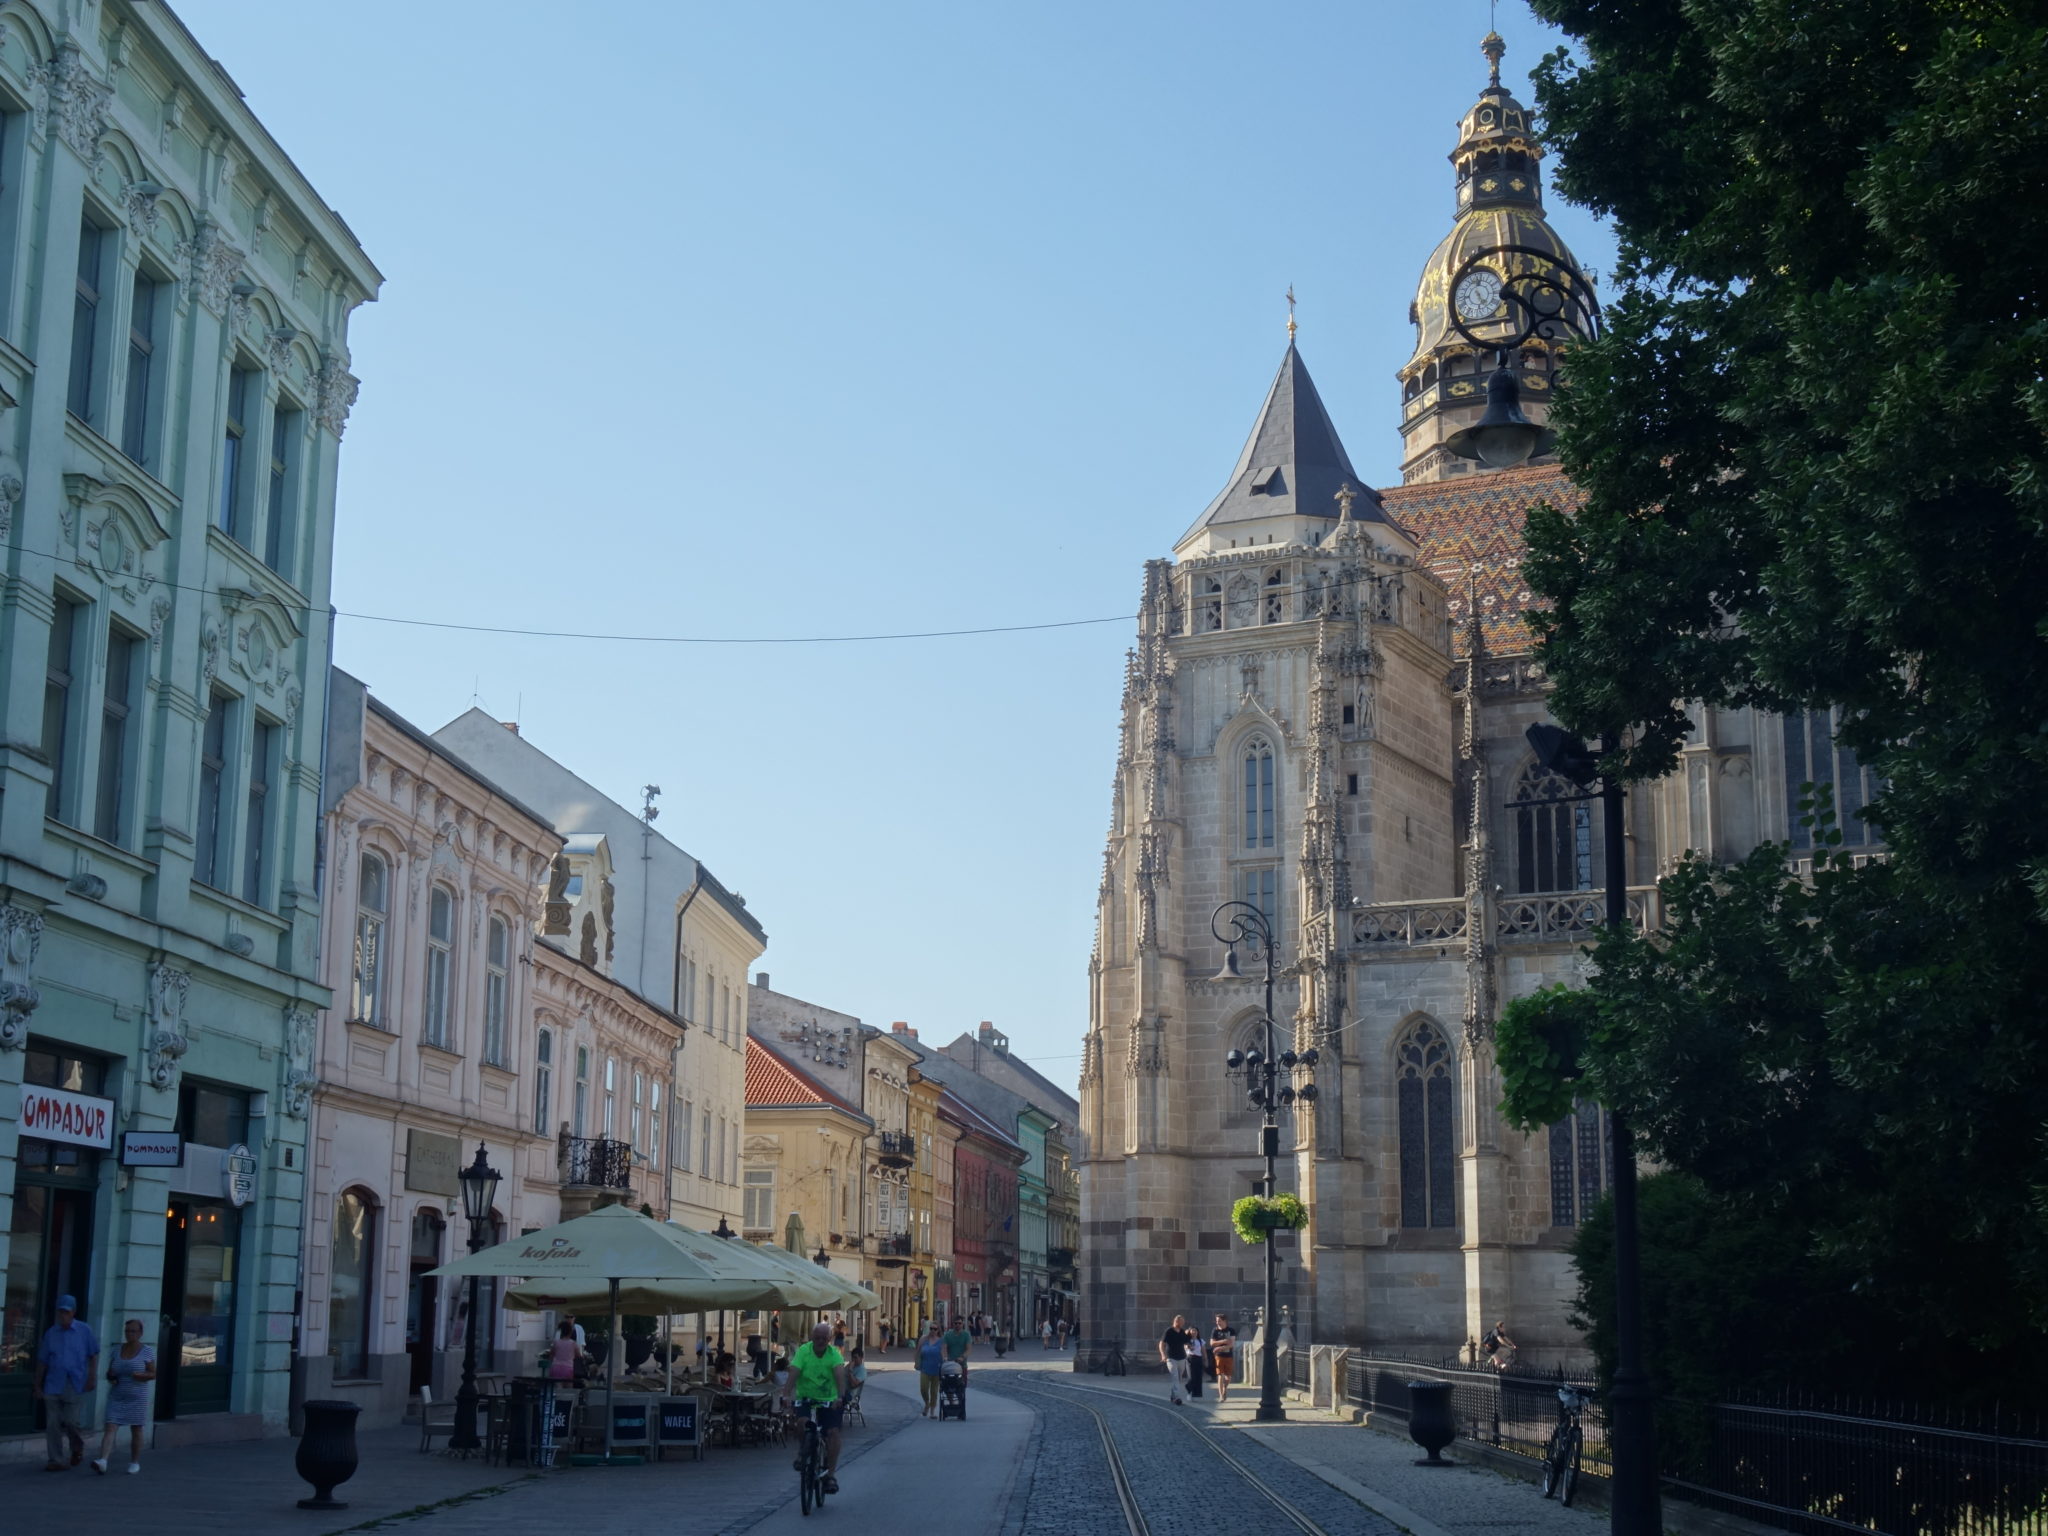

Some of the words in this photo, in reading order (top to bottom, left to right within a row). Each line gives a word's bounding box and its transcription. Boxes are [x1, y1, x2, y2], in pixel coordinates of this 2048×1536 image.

[20, 1094, 105, 1140] OMPADUR
[127, 1144, 178, 1154] POMPADUR
[519, 1245, 582, 1261] kofola
[664, 1415, 692, 1428] WAFLE
